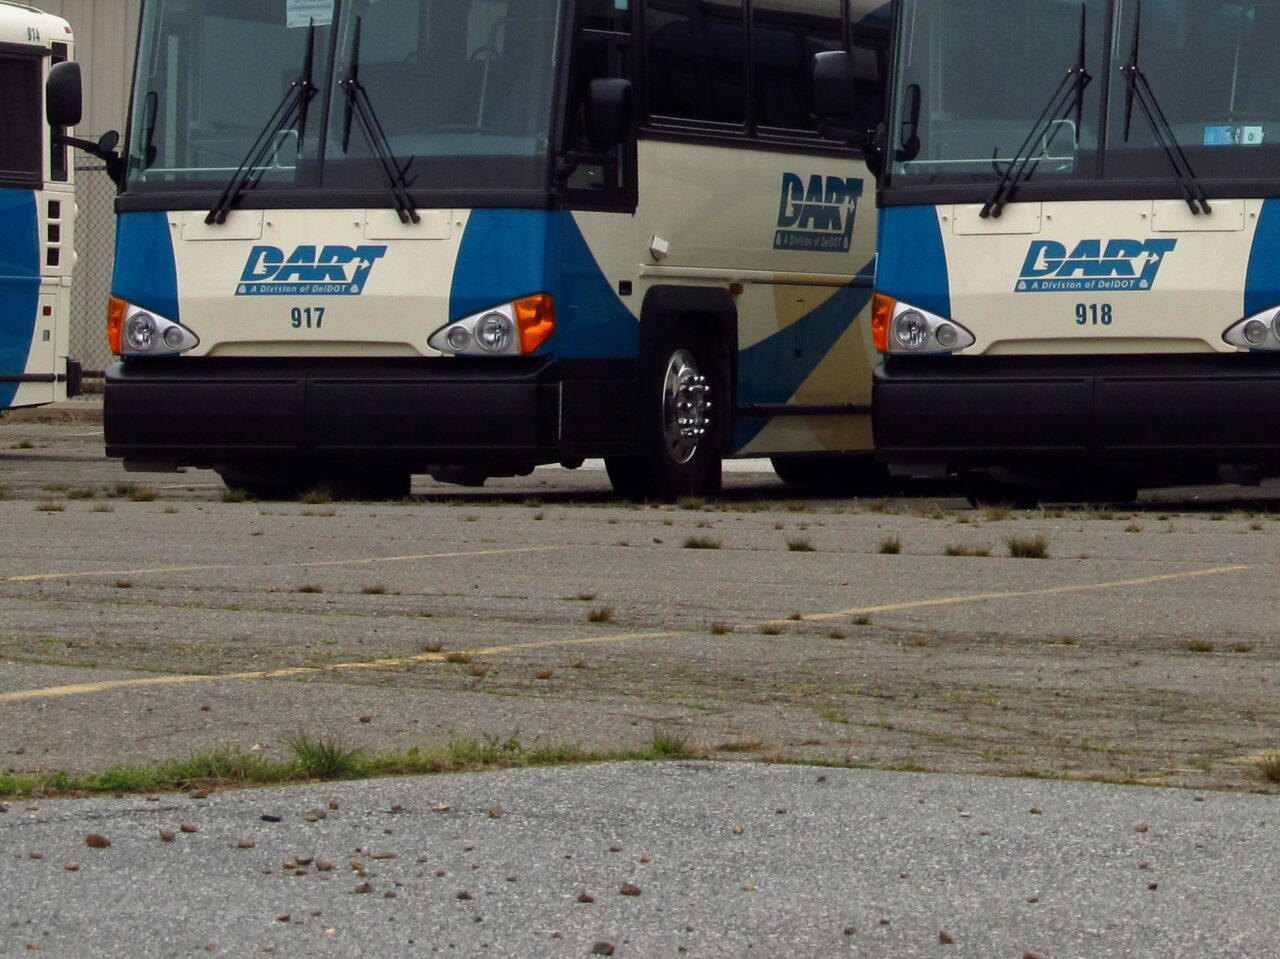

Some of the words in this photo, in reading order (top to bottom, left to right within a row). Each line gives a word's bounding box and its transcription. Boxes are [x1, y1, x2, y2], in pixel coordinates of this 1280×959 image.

[777, 171, 864, 231] DART
[239, 244, 389, 284] DART
[1018, 238, 1179, 280] DART
[250, 285, 258, 293] A
[259, 284, 297, 293] Division
[299, 284, 310, 293] of
[312, 284, 348, 293] DelDOT
[1031, 281, 1039, 289] A
[1041, 280, 1082, 289] Division
[1084, 280, 1096, 289] of
[1097, 279, 1136, 288] DelDOT
[290, 306, 326, 329] 917
[1075, 303, 1113, 326] 918
